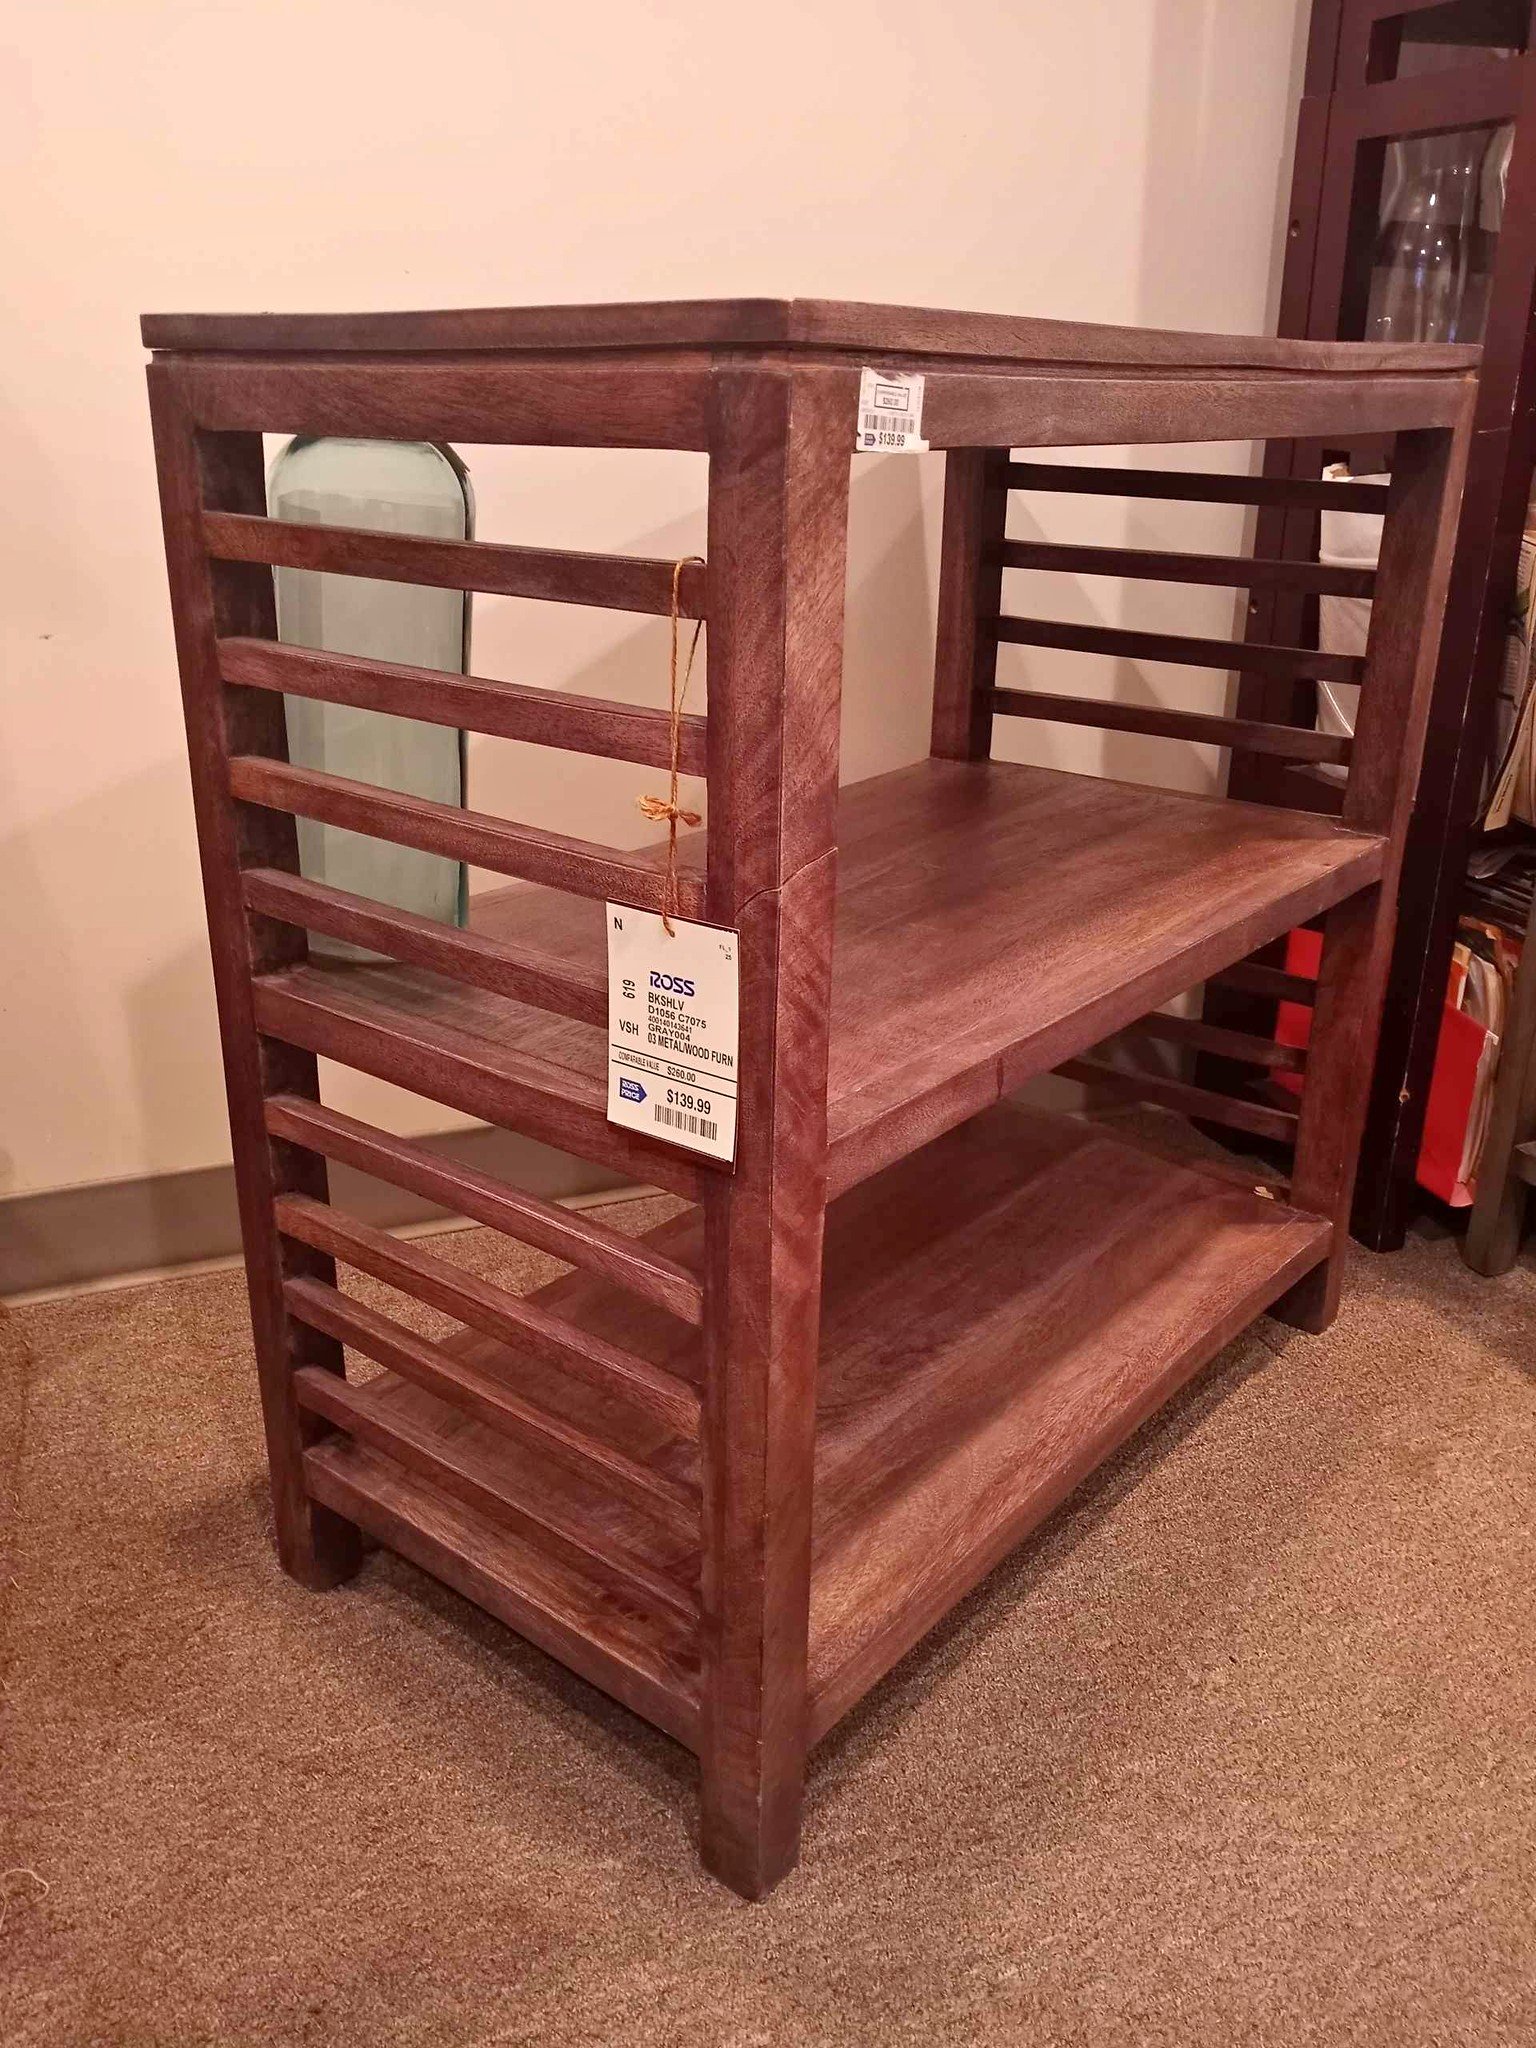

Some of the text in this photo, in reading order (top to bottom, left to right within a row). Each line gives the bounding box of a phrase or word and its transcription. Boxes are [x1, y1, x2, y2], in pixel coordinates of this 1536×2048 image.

[879, 432, 905, 446] $139.99
[613, 917, 623, 930] N
[623, 979, 635, 999] 619
[650, 970, 695, 997] ROSS
[648, 992, 684, 1011] BKSHLV
[648, 1004, 707, 1029] D1056 C7075
[619, 1019, 639, 1036] VSH
[648, 1023, 690, 1041] GRAY004
[647, 1032, 656, 1044] 03
[711, 1050, 734, 1067] FURN
[667, 1066, 696, 1083] $260.00
[667, 1089, 711, 1115] $139.99
